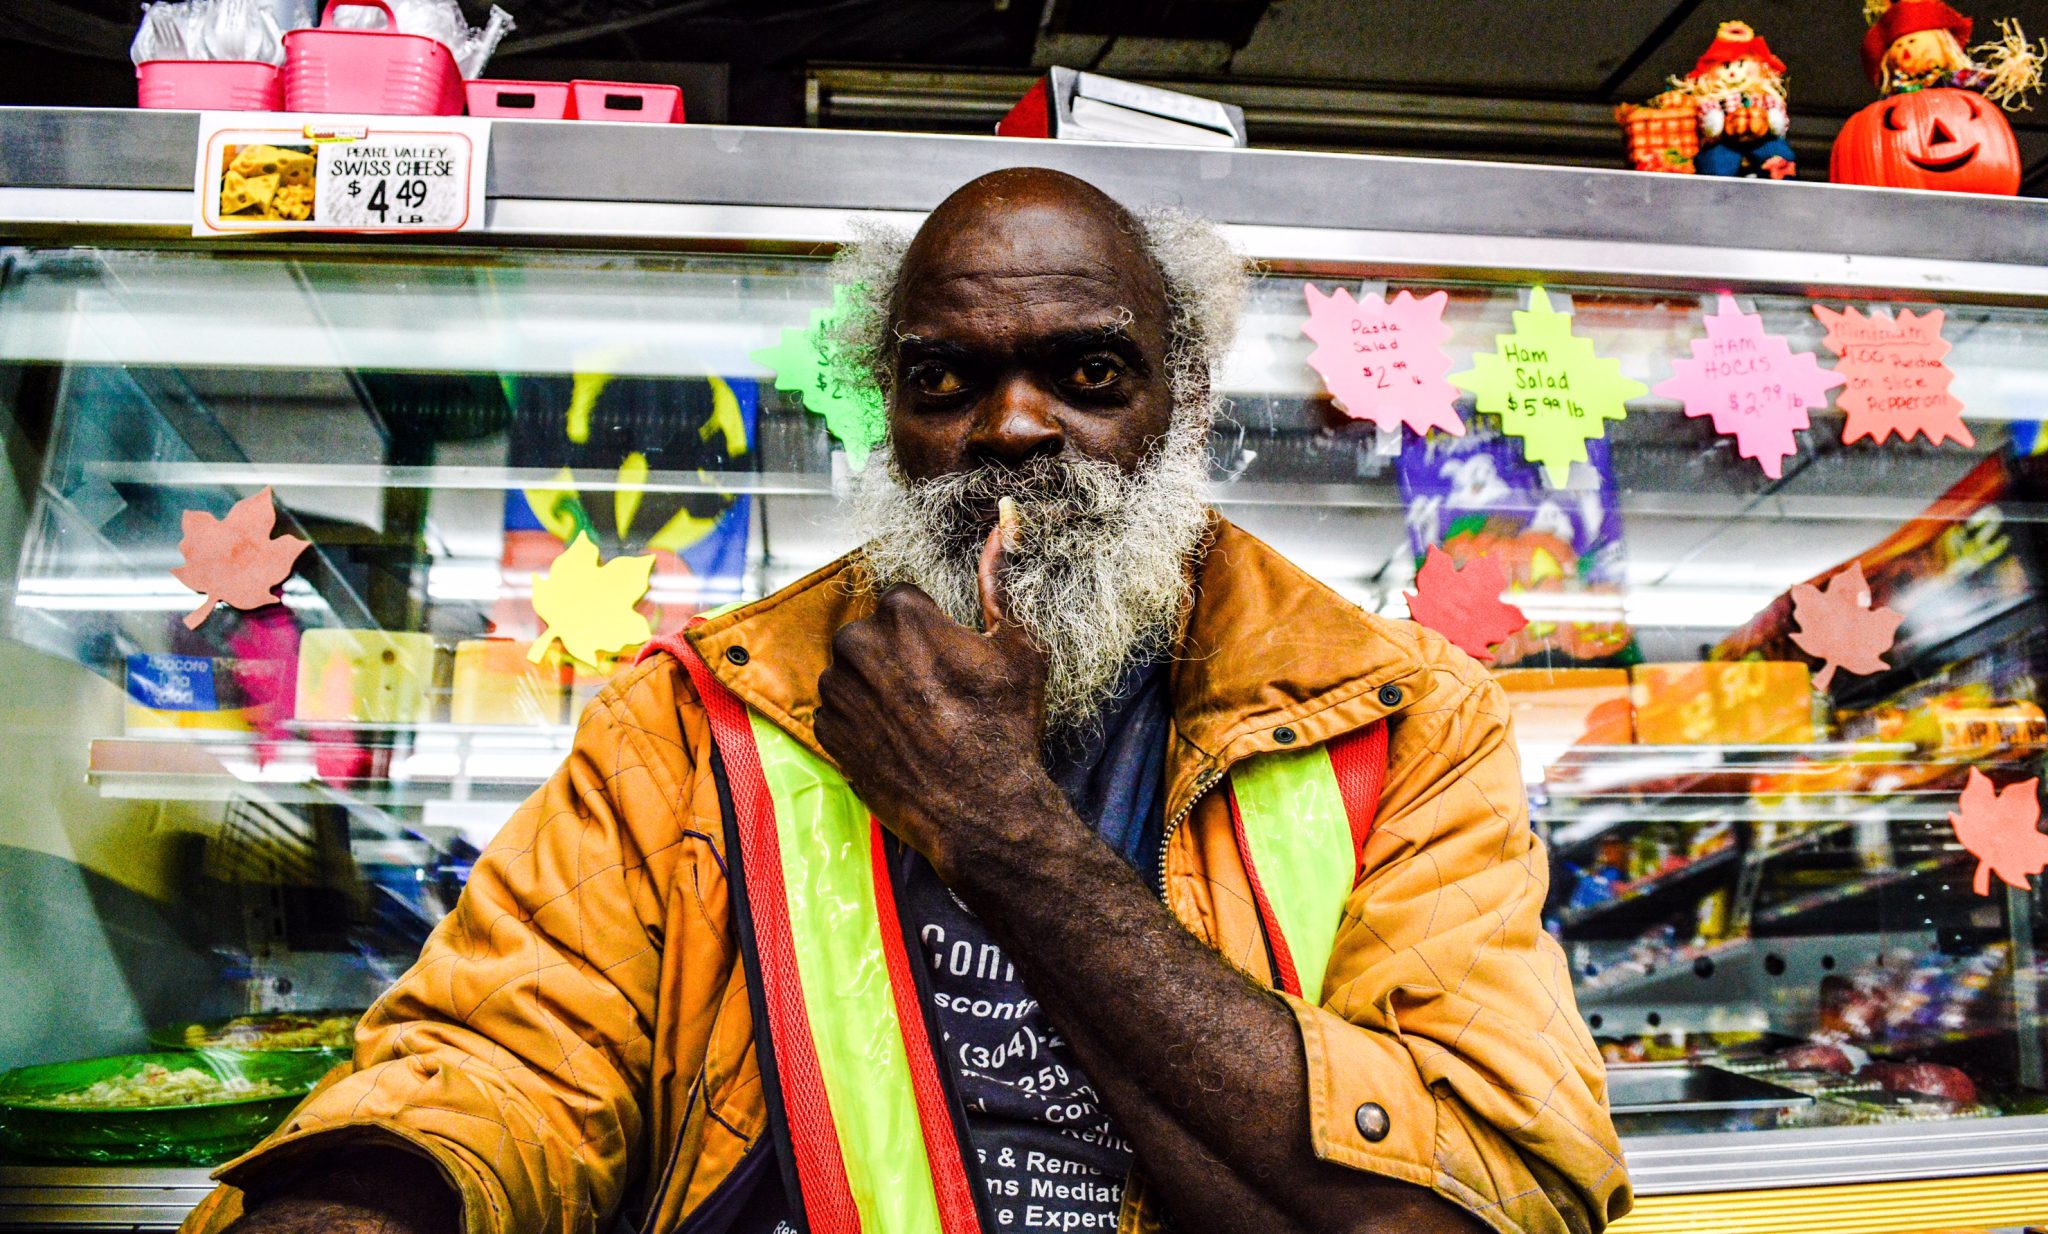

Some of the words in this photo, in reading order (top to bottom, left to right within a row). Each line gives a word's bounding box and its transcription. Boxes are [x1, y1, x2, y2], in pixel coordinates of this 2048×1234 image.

[346, 146, 391, 159] PEARL
[395, 147, 447, 159] VALLEY
[331, 160, 391, 177] SWISS
[396, 160, 454, 177] CHEESE
[398, 214, 424, 224] LB
[1352, 319, 1401, 335] Pasta
[1353, 339, 1398, 352] Salad
[1506, 344, 1548, 363] Ham
[1713, 337, 1757, 355] HAM
[1704, 356, 1771, 380] HOCKS
[1516, 368, 1569, 390] Salad
[1567, 400, 1585, 418] lb
[1787, 392, 1804, 411] lb
[1018, 1064, 1070, 1094] 259
[998, 1147, 1017, 1169] &
[1031, 1178, 1126, 1203] Mediat
